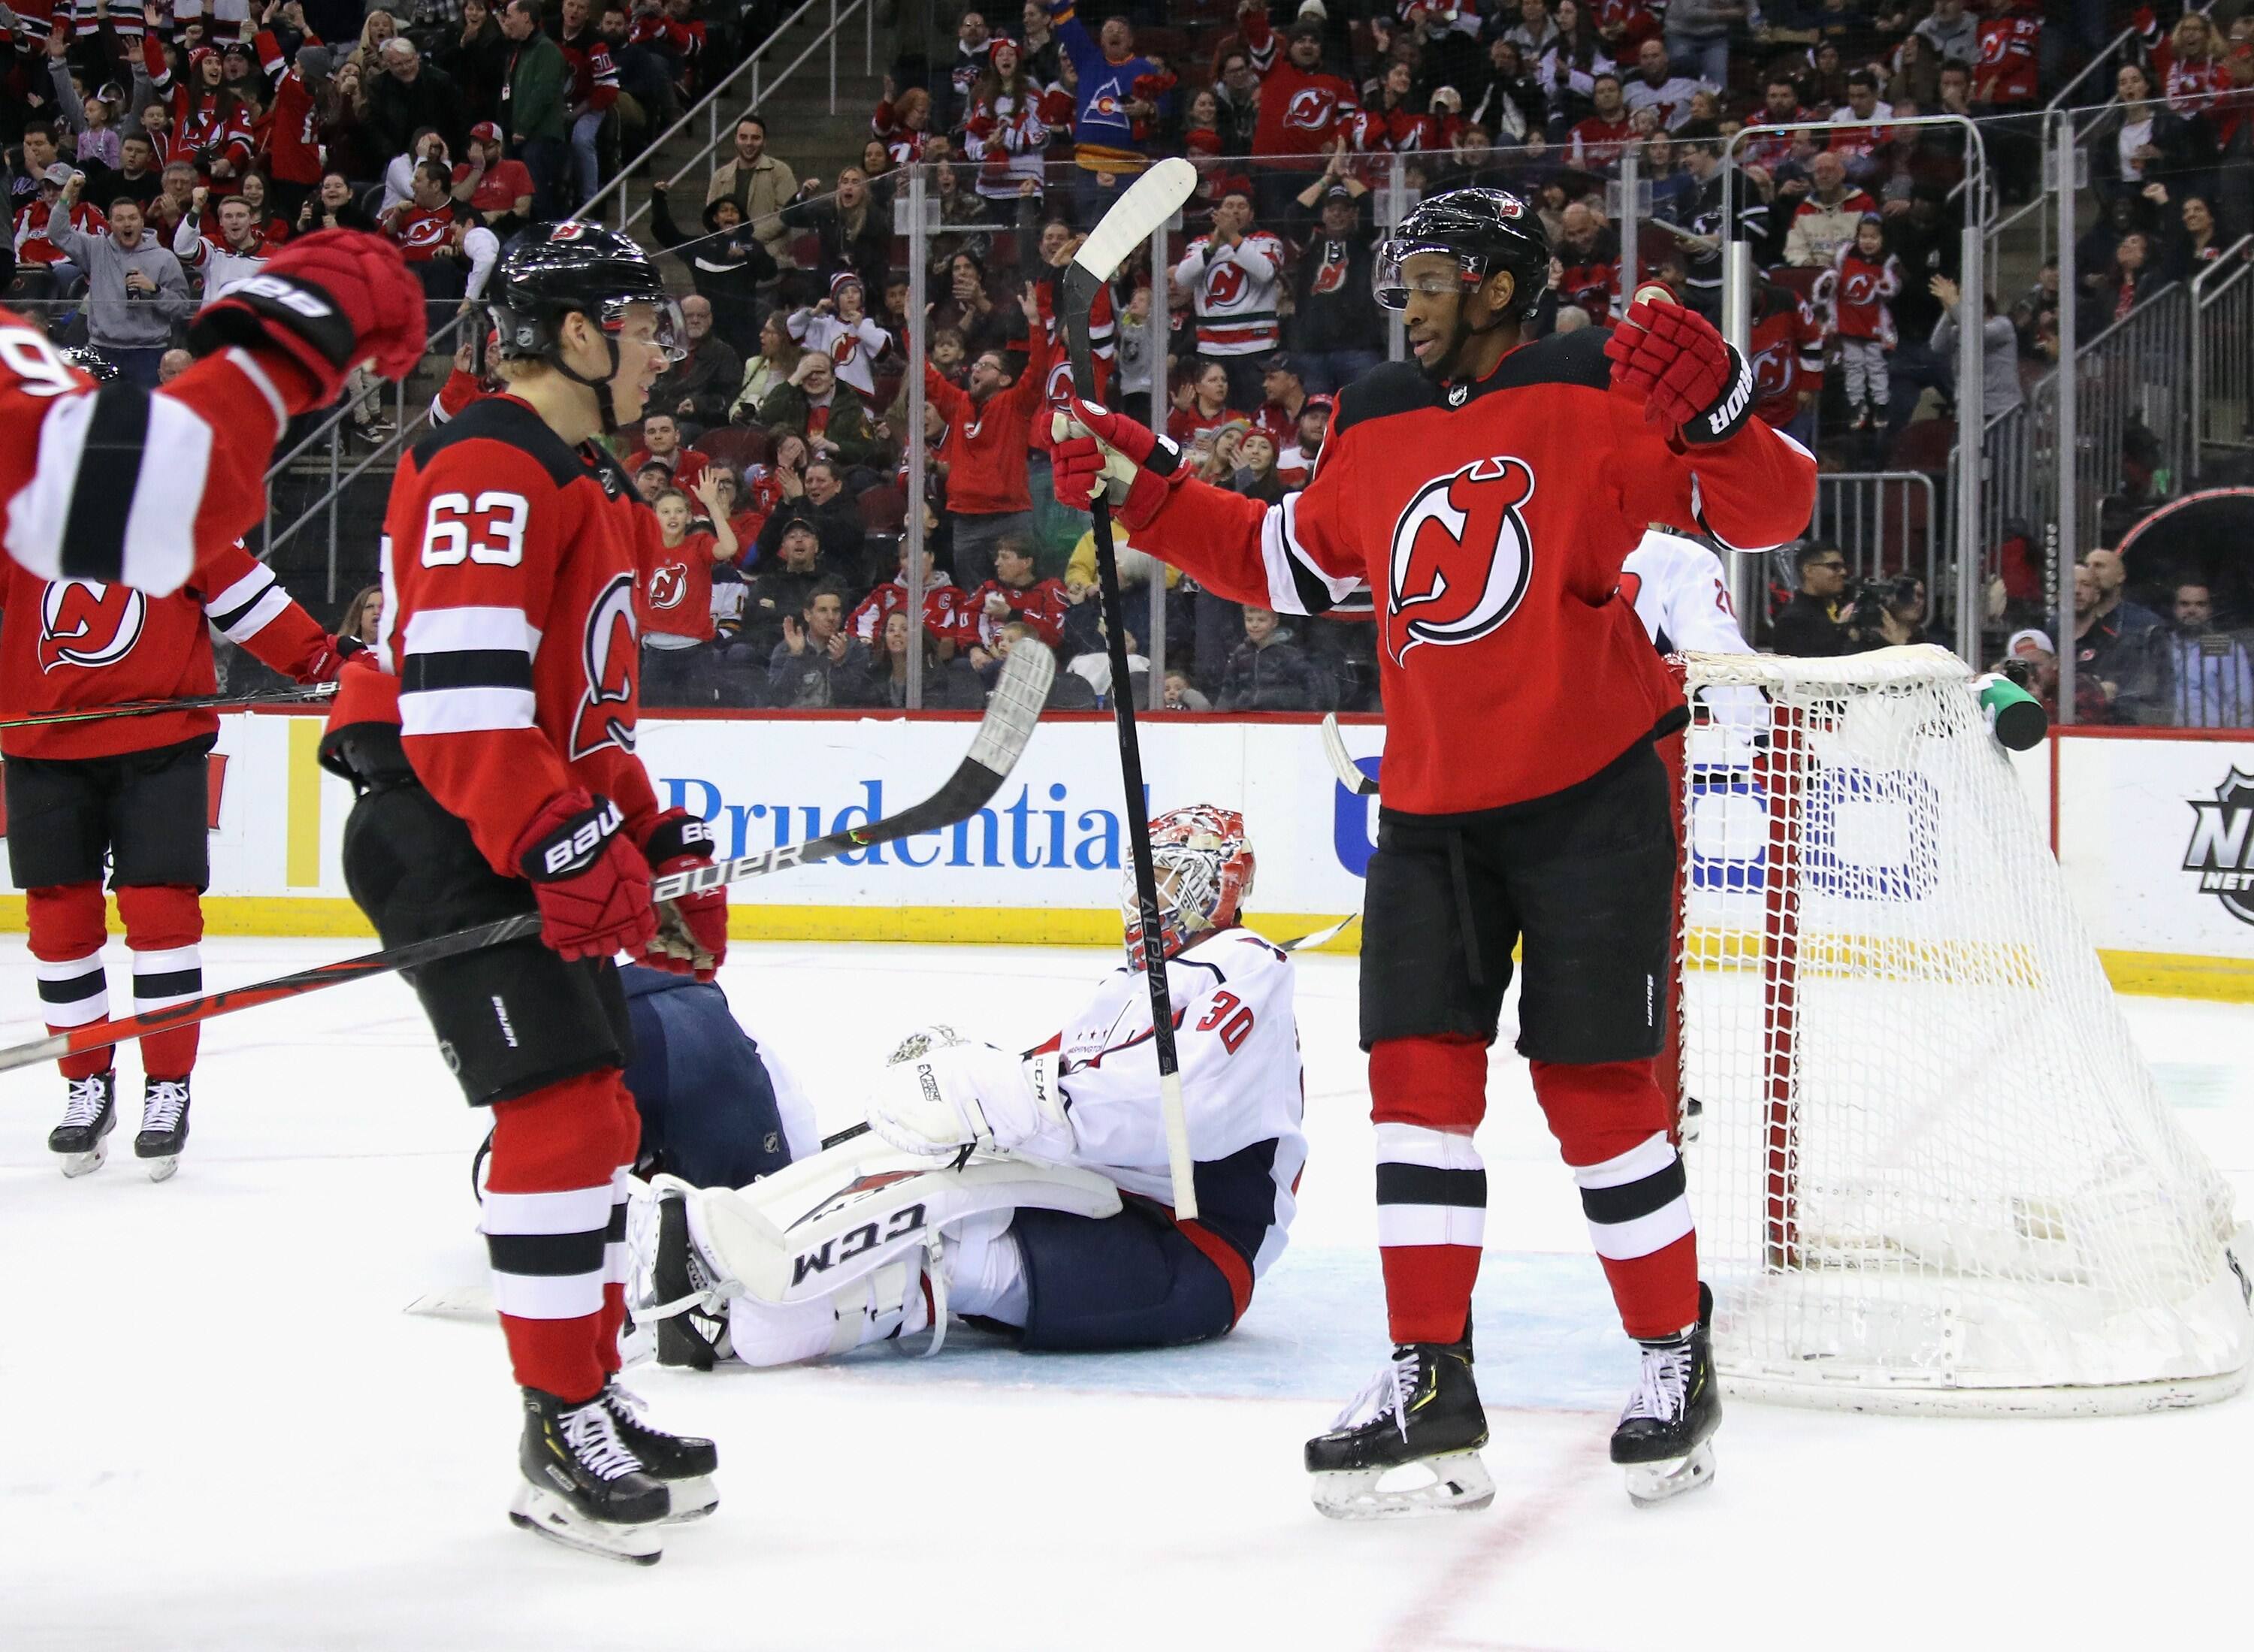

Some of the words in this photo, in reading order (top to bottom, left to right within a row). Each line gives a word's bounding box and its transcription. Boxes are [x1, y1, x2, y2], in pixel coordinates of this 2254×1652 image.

[421, 491, 529, 569] 63
[1715, 578, 1737, 620] 2
[660, 778, 1150, 871] Prudentia
[652, 842, 806, 902] AUER
[491, 995, 518, 1048] BAUER
[1196, 990, 1255, 1056] 30
[1646, 974, 1654, 1027] BAUER
[1033, 1058, 1047, 1101] CCM
[791, 1202, 929, 1287] CCM
